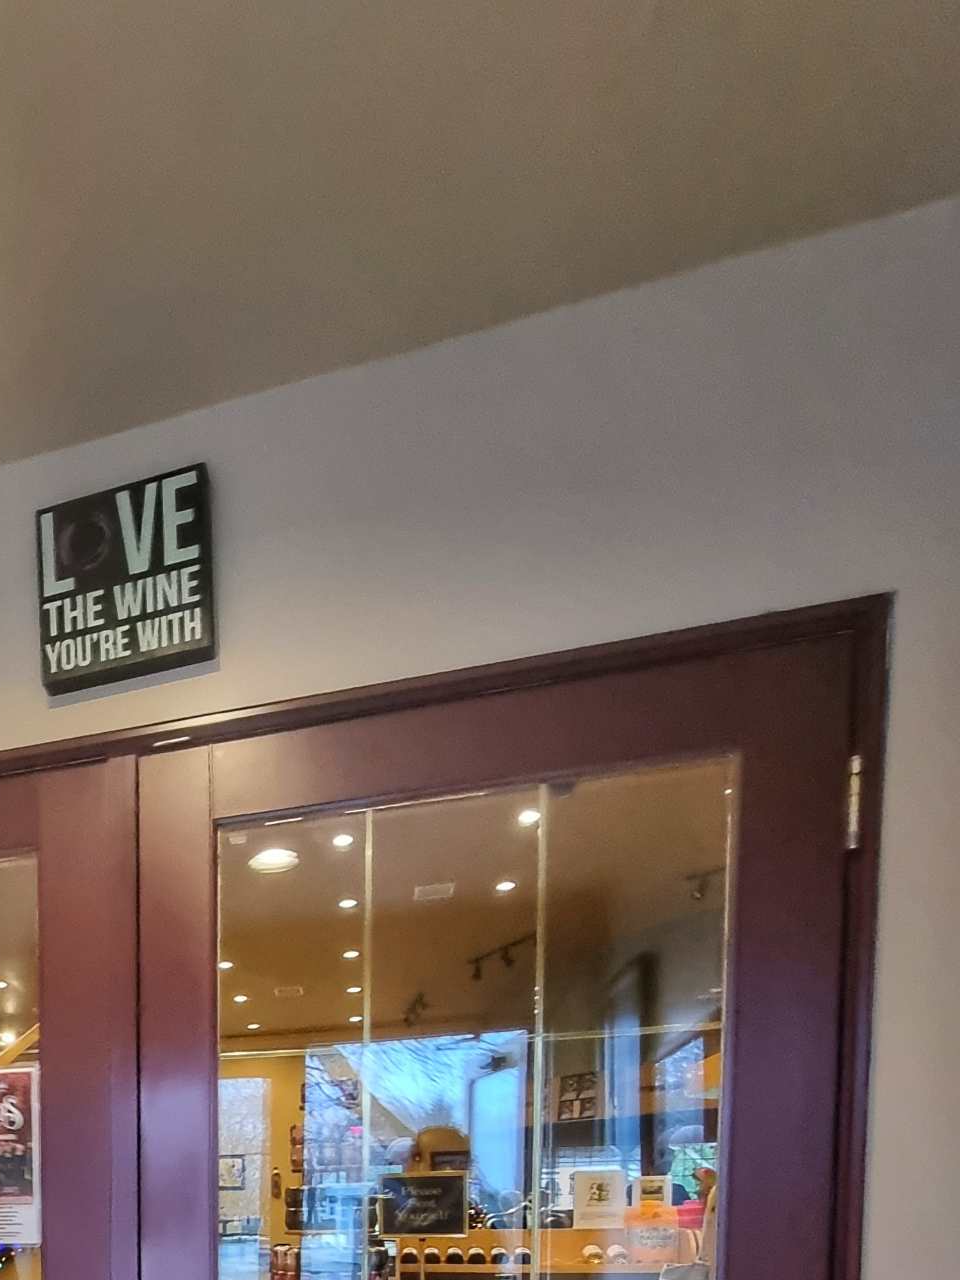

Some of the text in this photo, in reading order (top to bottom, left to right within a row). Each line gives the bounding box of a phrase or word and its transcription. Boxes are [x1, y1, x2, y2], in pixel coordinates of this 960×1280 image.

[42, 563, 201, 638] THE WINE
[44, 606, 202, 674] YOU'RE WITH
